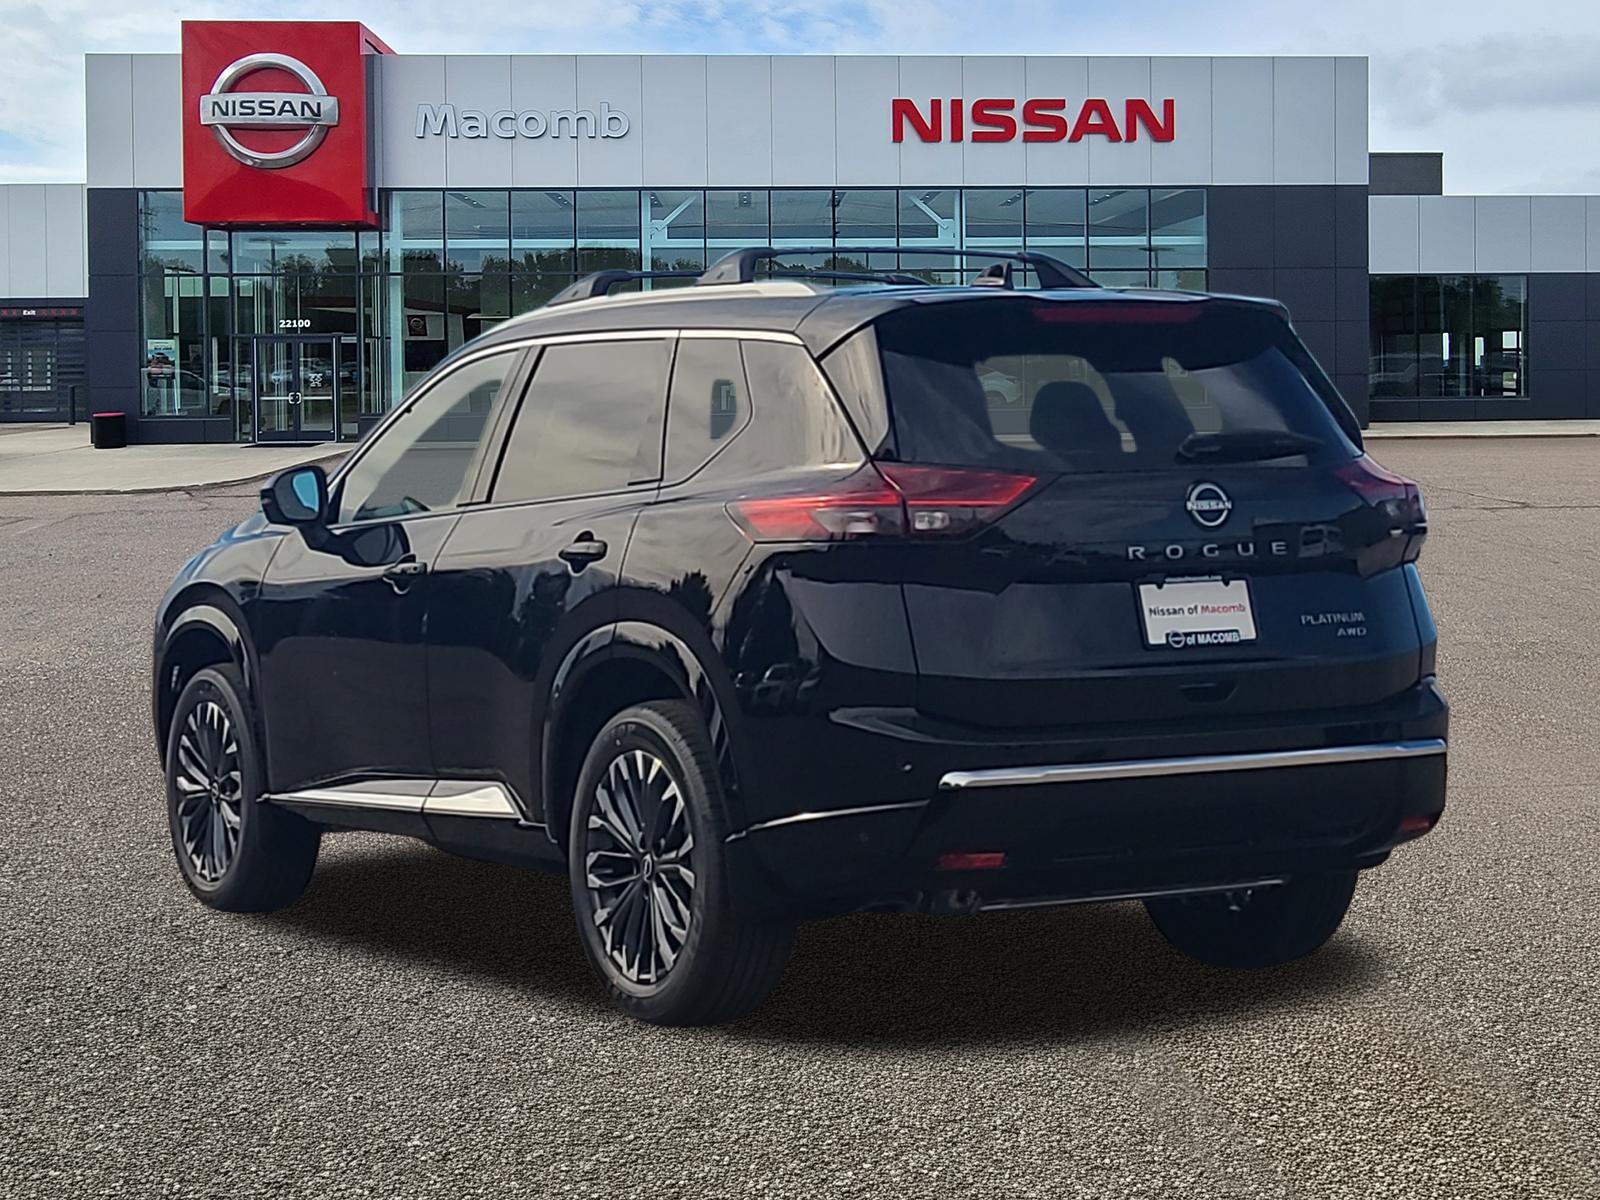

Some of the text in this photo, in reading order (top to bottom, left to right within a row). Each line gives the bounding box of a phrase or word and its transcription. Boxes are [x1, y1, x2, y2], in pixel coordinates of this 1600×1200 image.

[212, 100, 321, 117] NISSAN
[415, 102, 630, 139] Macomb
[891, 98, 1175, 143] NISSAN
[279, 319, 311, 328] 22100
[1186, 500, 1232, 511] NISSAN
[1128, 541, 1287, 560] ROGUE
[1149, 603, 1246, 617] Nissan of Macomb
[1300, 611, 1365, 625] PLATINUM
[1197, 632, 1240, 644] MACOMB
[1337, 627, 1367, 637] AWD
